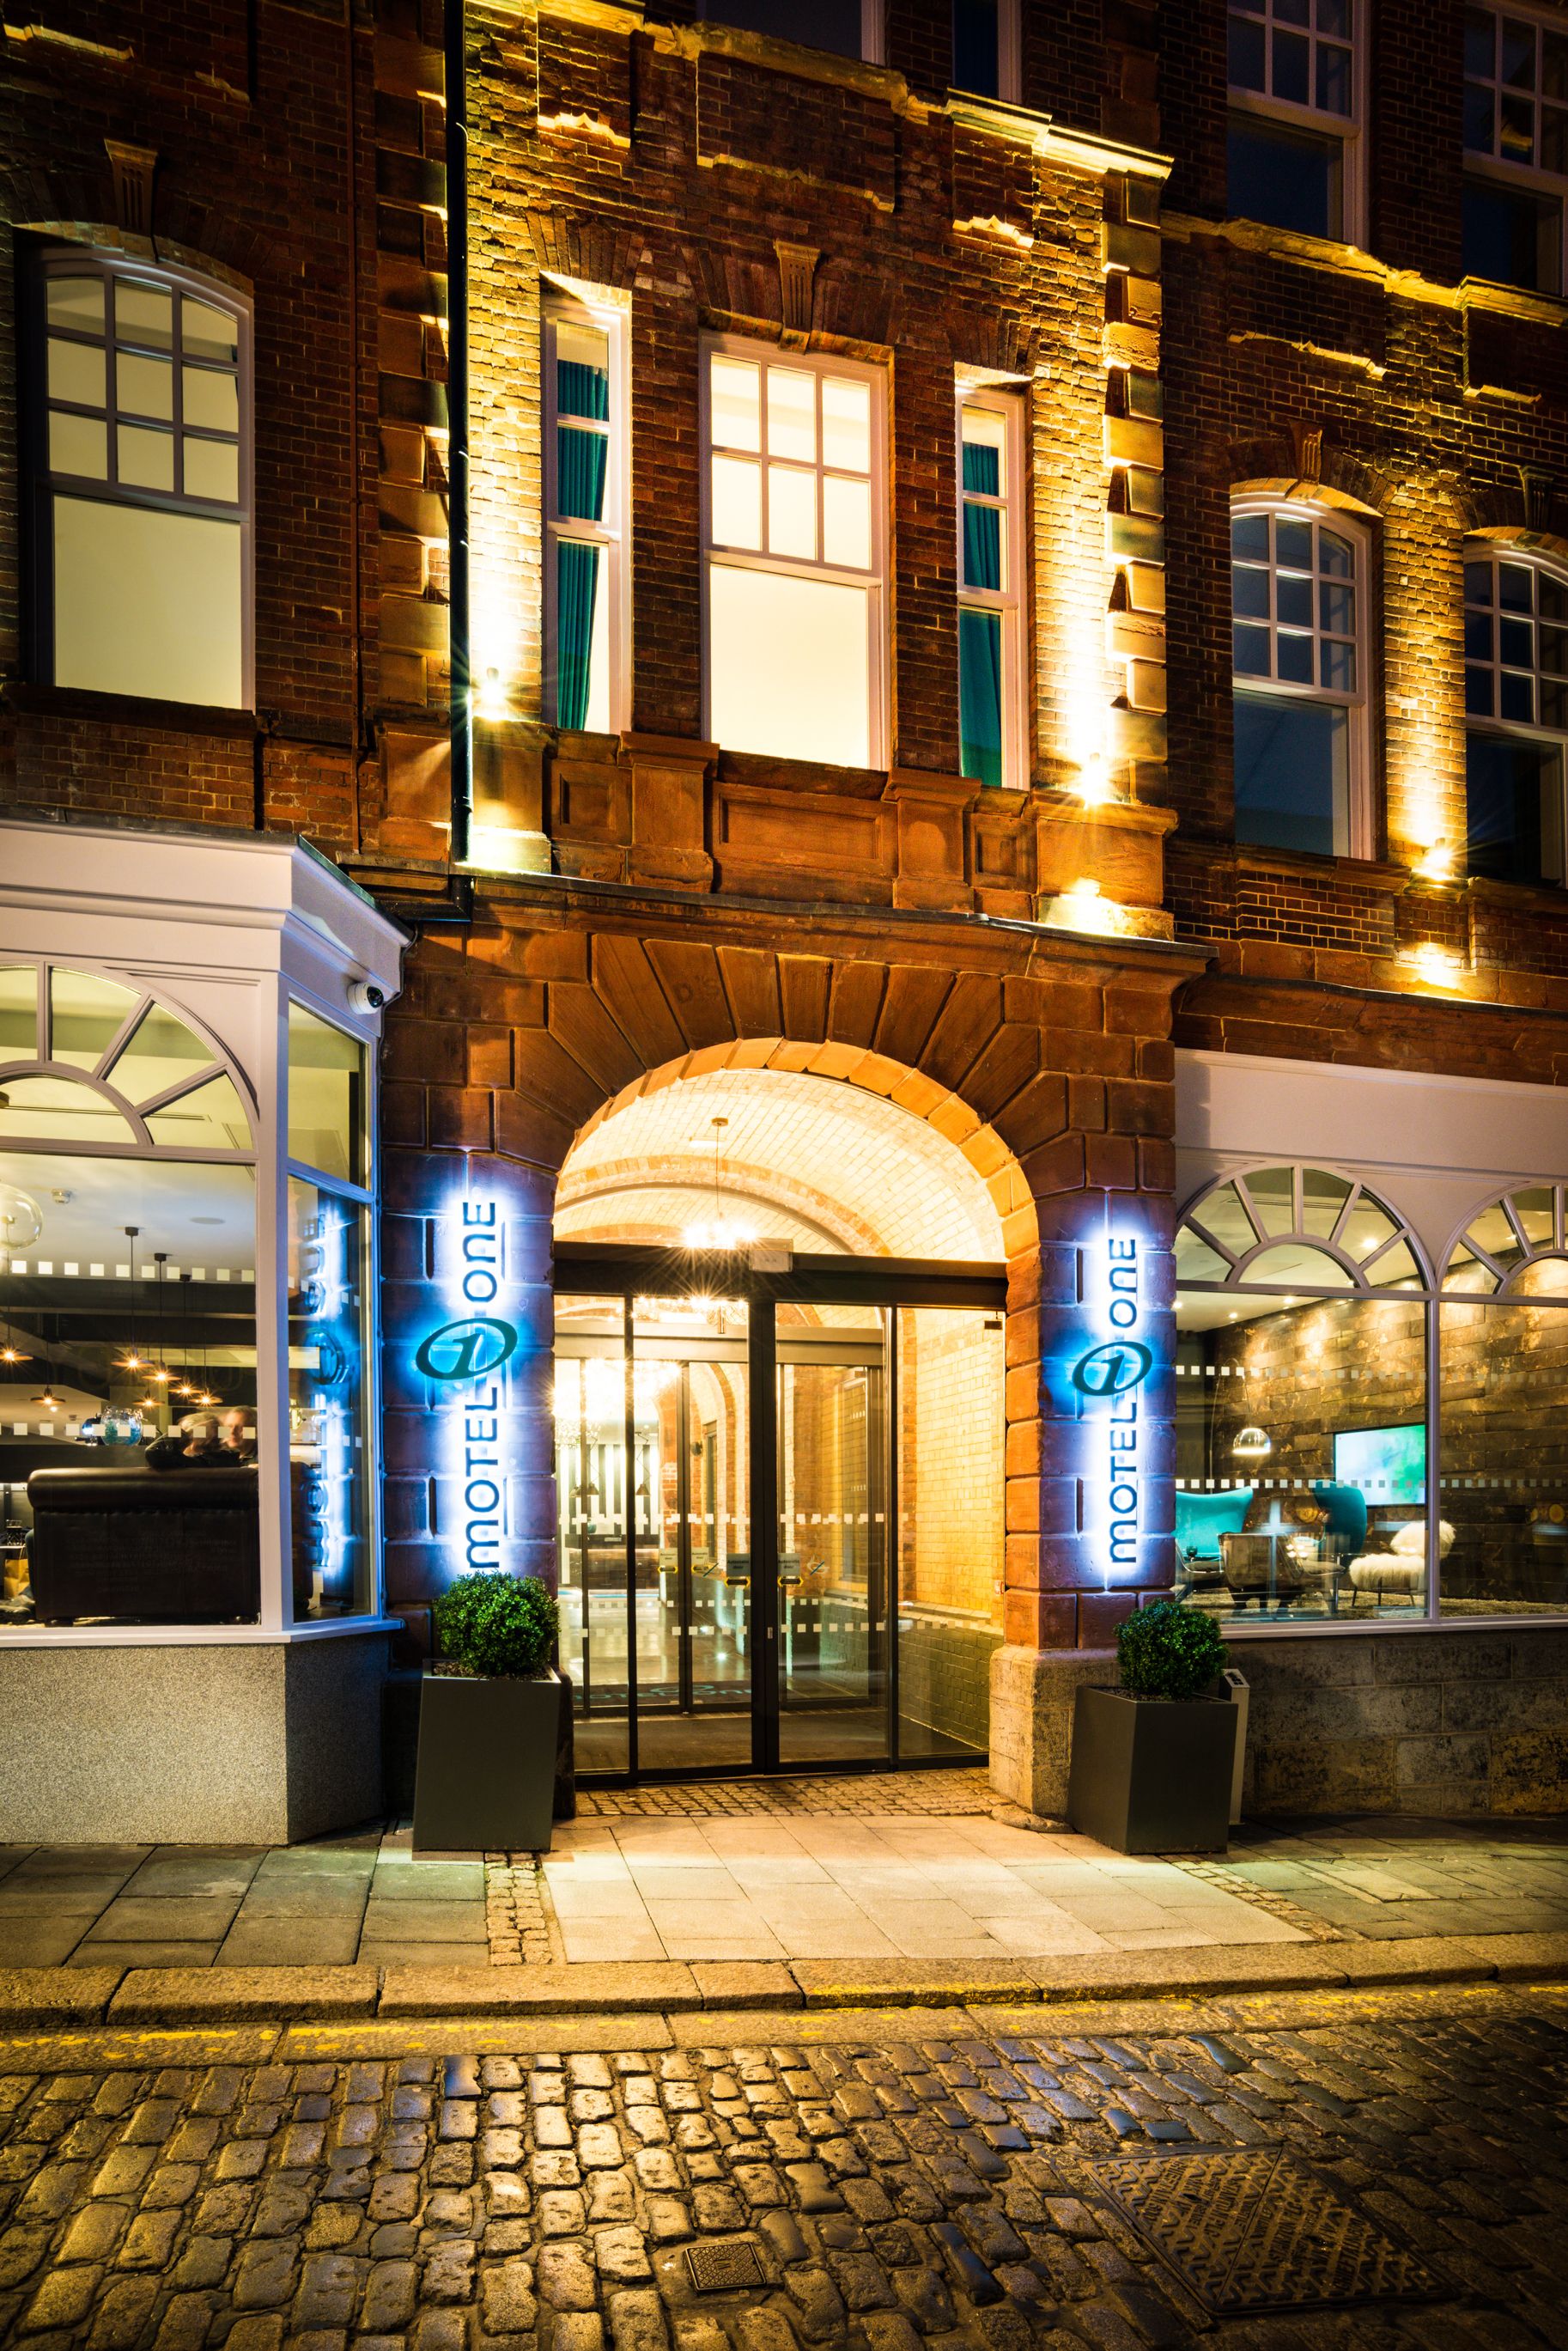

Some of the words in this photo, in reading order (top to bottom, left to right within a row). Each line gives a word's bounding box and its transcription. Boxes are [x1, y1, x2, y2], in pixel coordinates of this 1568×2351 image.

[461, 1202, 498, 1305] ONE
[1108, 1238, 1138, 1329] ONE
[465, 1386, 500, 1569] MOTEL
[1109, 1402, 1139, 1563] MOTEL
